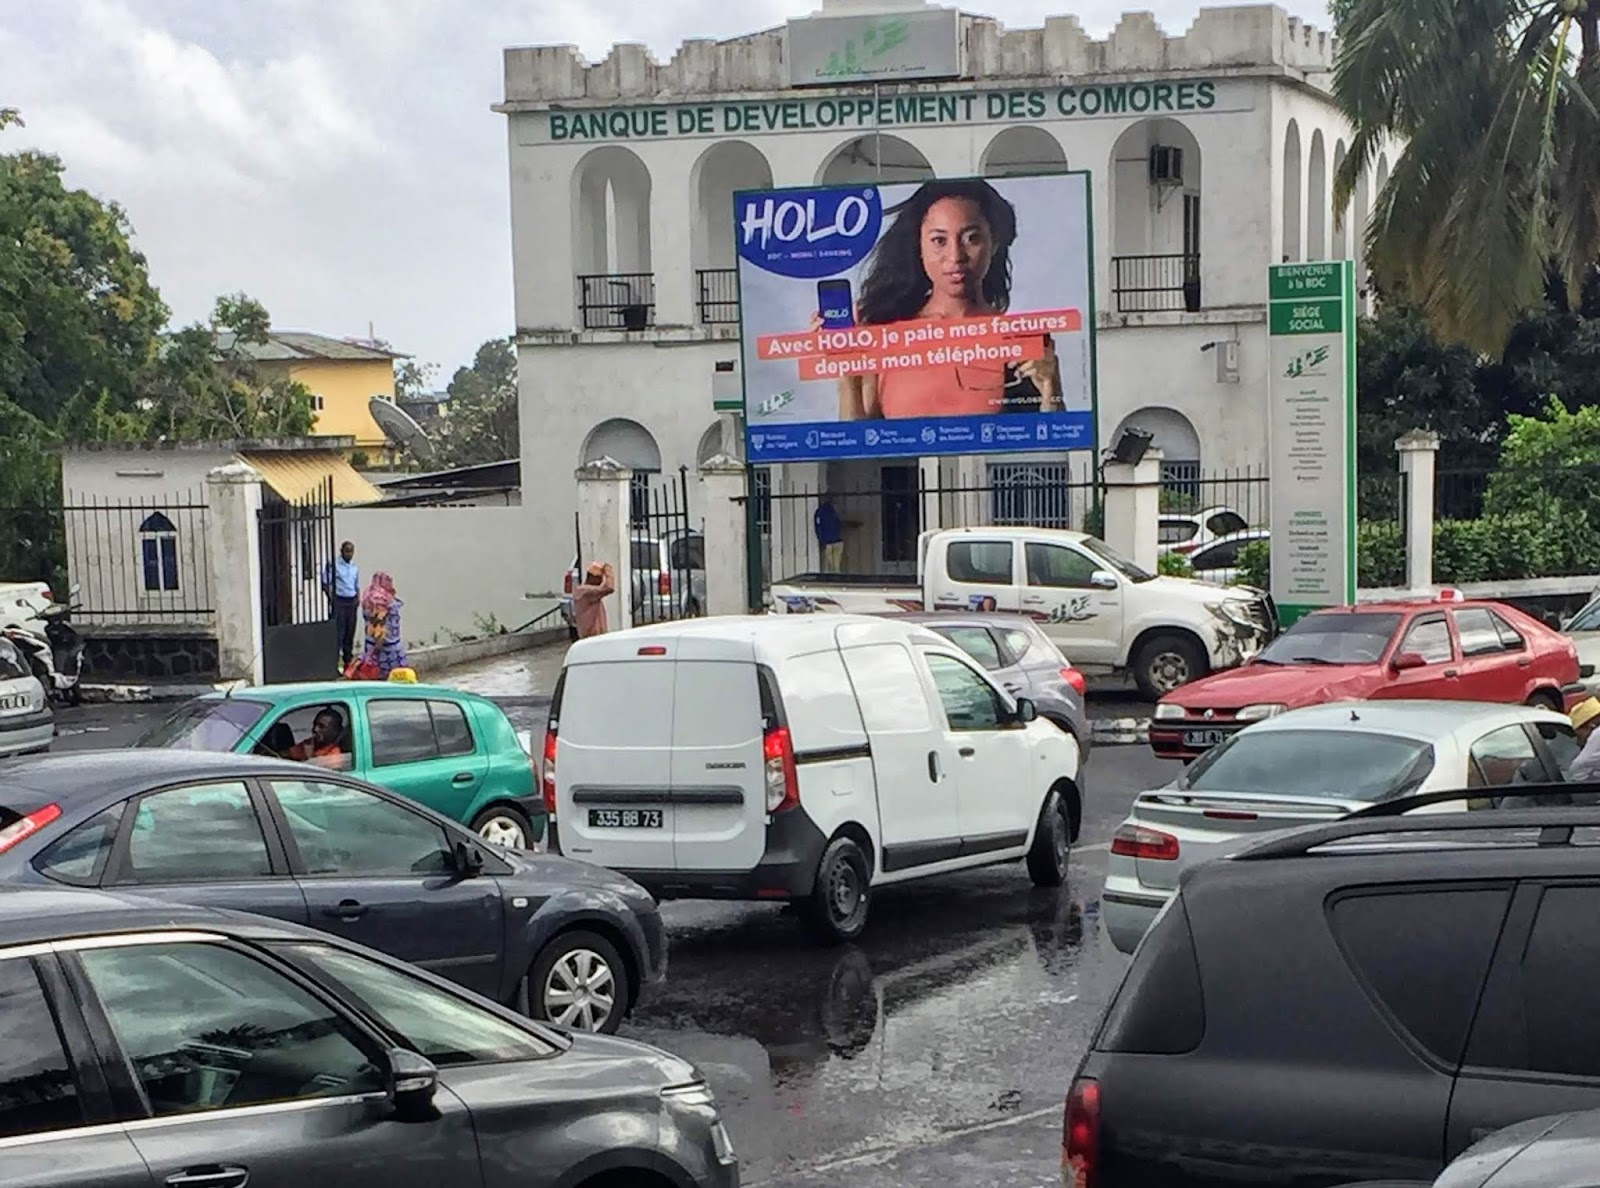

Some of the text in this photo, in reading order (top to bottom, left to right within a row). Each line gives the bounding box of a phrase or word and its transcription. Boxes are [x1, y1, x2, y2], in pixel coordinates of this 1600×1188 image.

[550, 81, 1216, 140] BANQUE DE DEVELOPPEMENT DES COMORES
[741, 196, 869, 250] HOLO
[1278, 265, 1332, 277] BIENVENUE
[1305, 277, 1326, 288] BDC
[768, 315, 1067, 355] Avec HOLO, je paie mes factures
[1288, 318, 1324, 330] SOCIAL
[815, 343, 1022, 376] depuis mon téléphone
[596, 810, 620, 827] 335
[643, 812, 660, 827] 73
